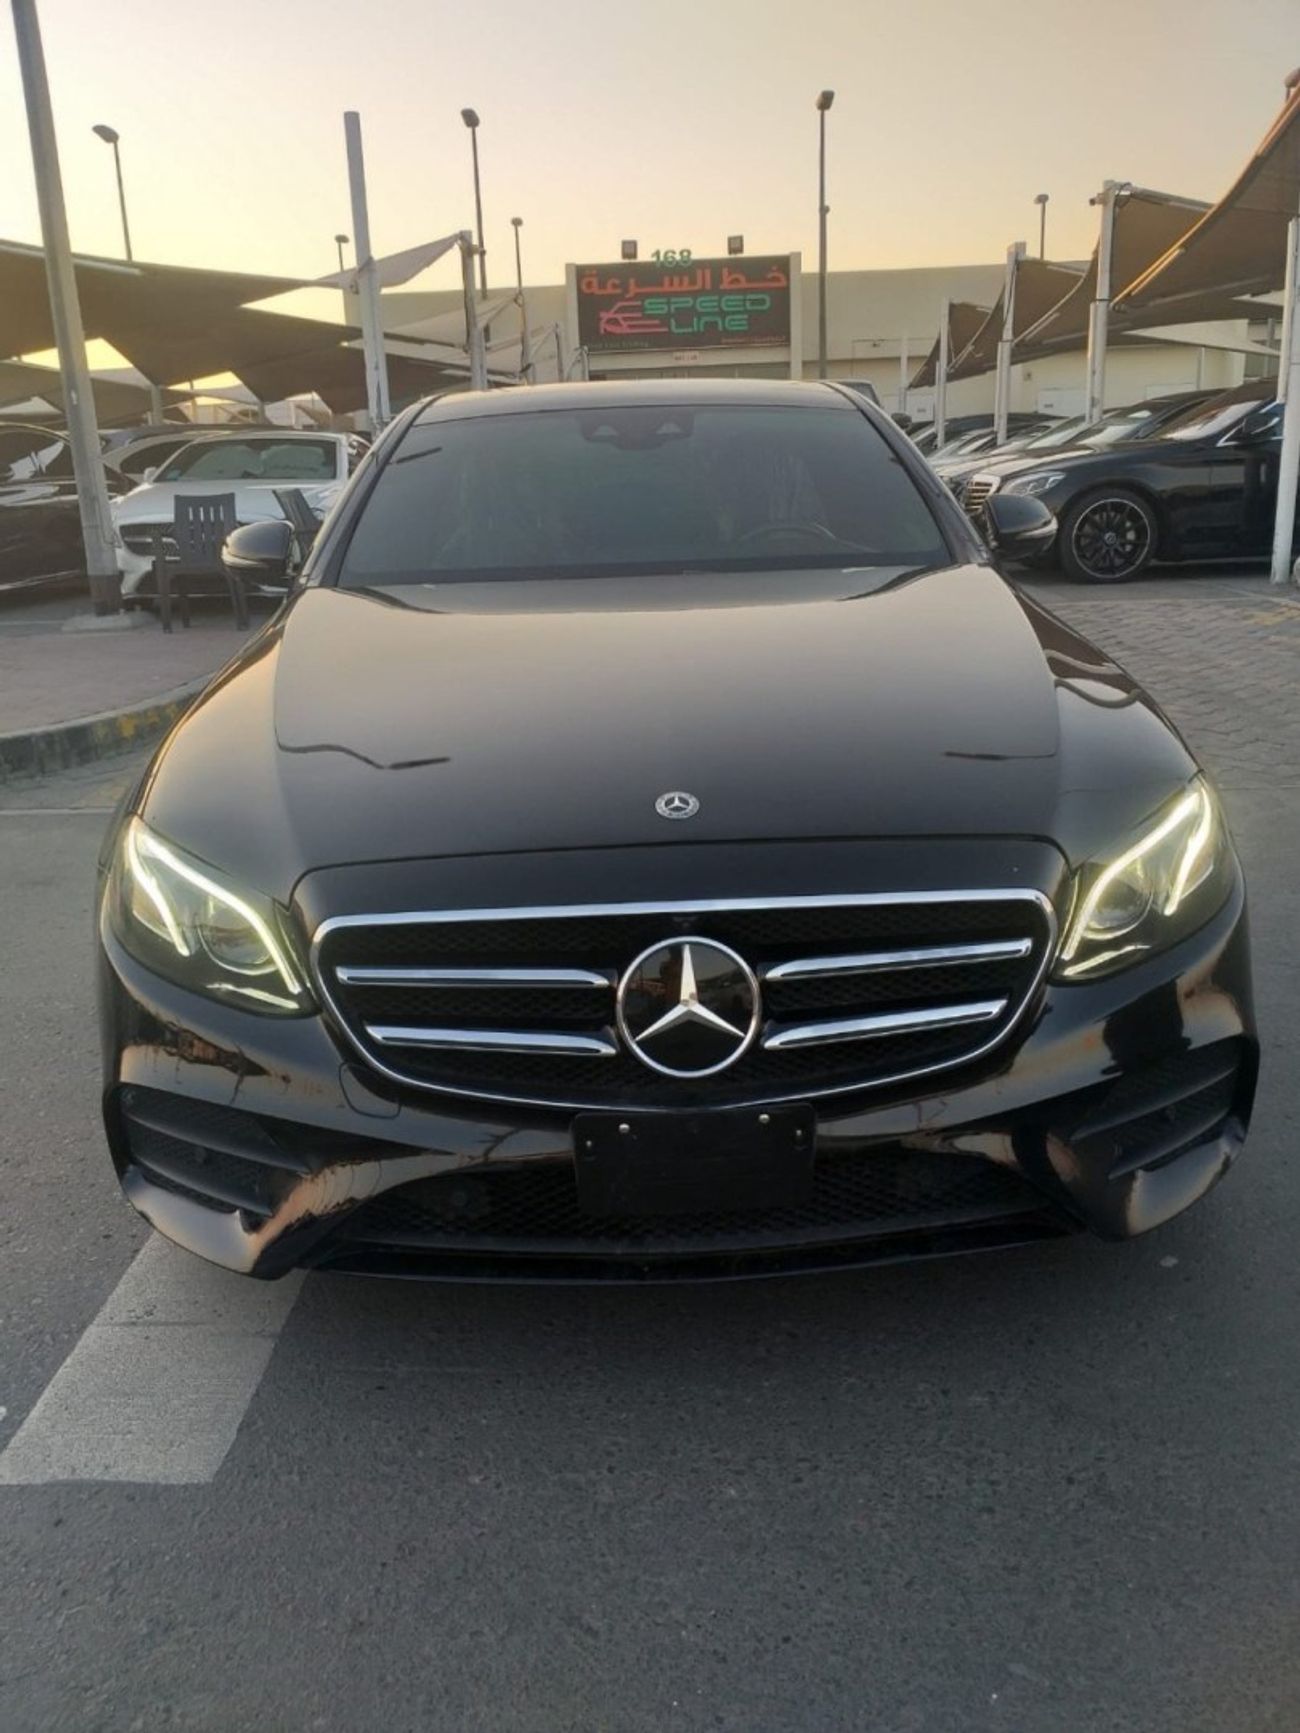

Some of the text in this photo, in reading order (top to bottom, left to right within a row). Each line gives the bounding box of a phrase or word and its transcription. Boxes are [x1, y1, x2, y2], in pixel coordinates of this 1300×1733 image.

[652, 249, 692, 268] 168
[581, 266, 787, 298] خط السرعة
[645, 294, 770, 314] SPEED
[671, 314, 748, 334] LINE
